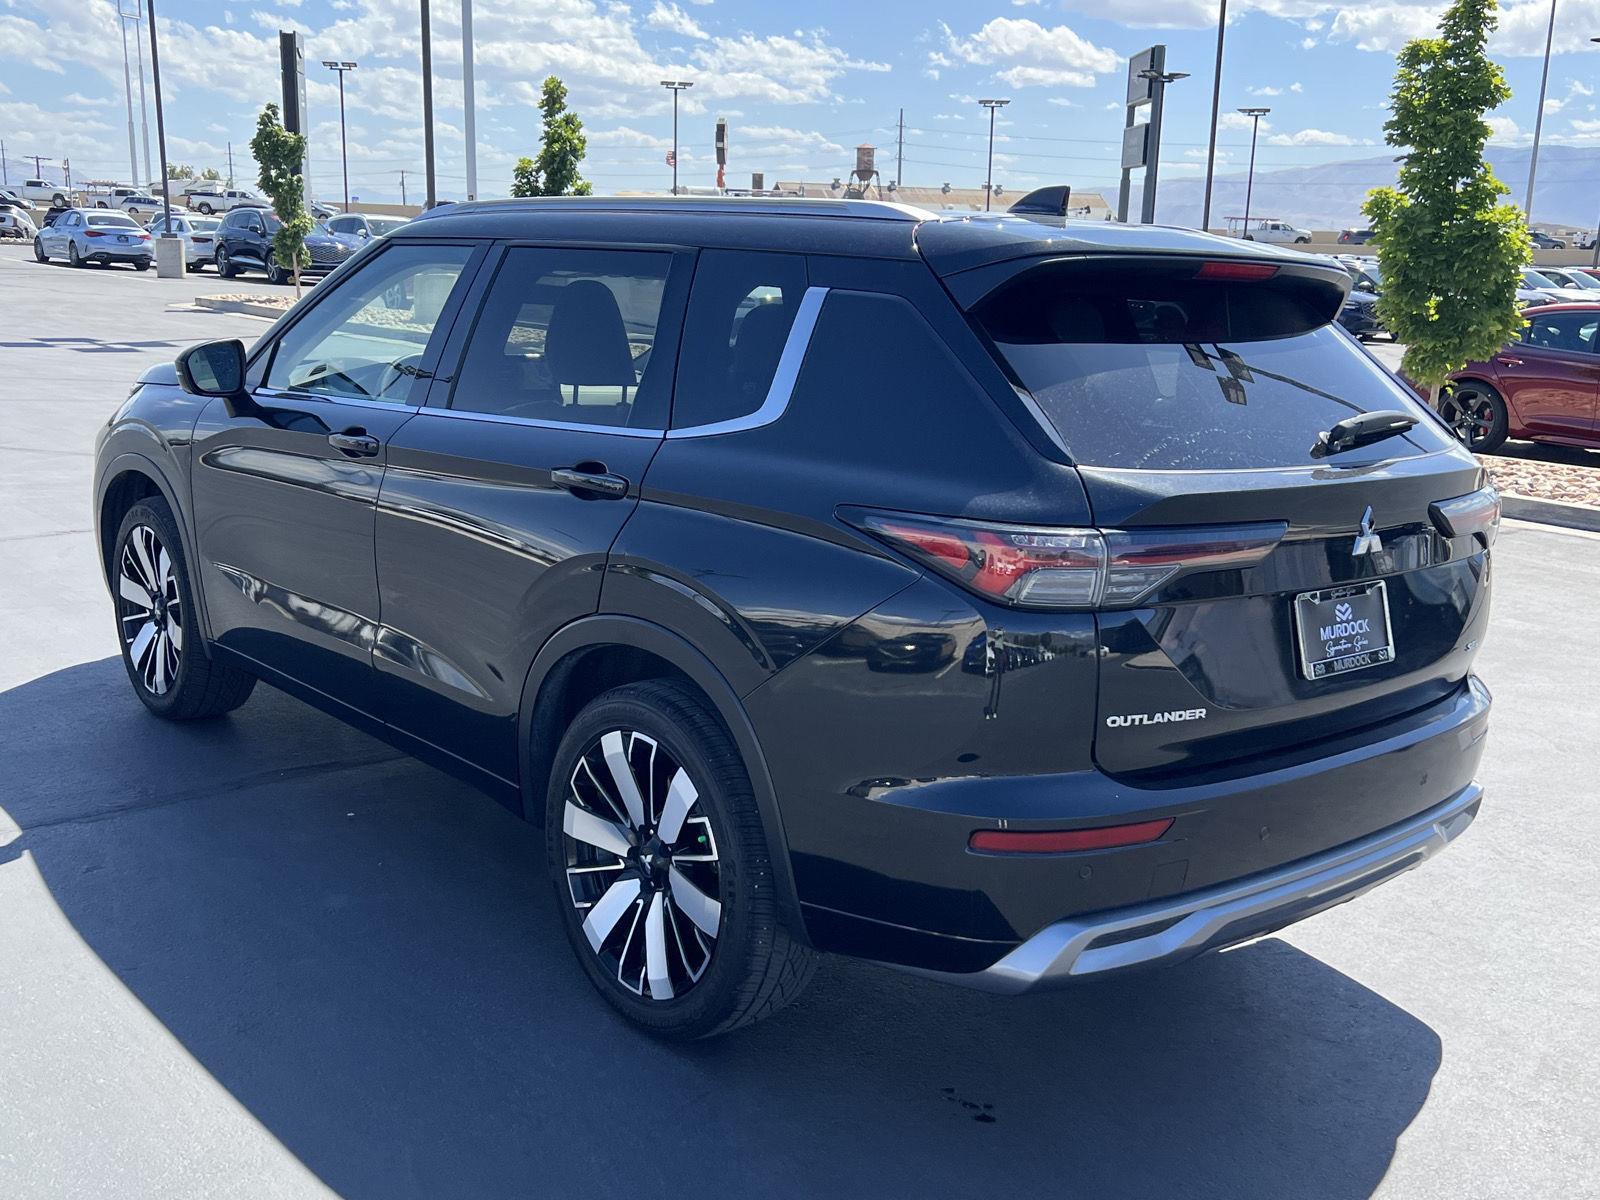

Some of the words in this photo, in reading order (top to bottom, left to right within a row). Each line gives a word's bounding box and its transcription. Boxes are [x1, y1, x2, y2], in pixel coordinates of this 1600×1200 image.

[1320, 619, 1370, 641] MURDOCK
[1333, 654, 1371, 671] MURDOCK
[1106, 708, 1207, 728] OUTLANDER
